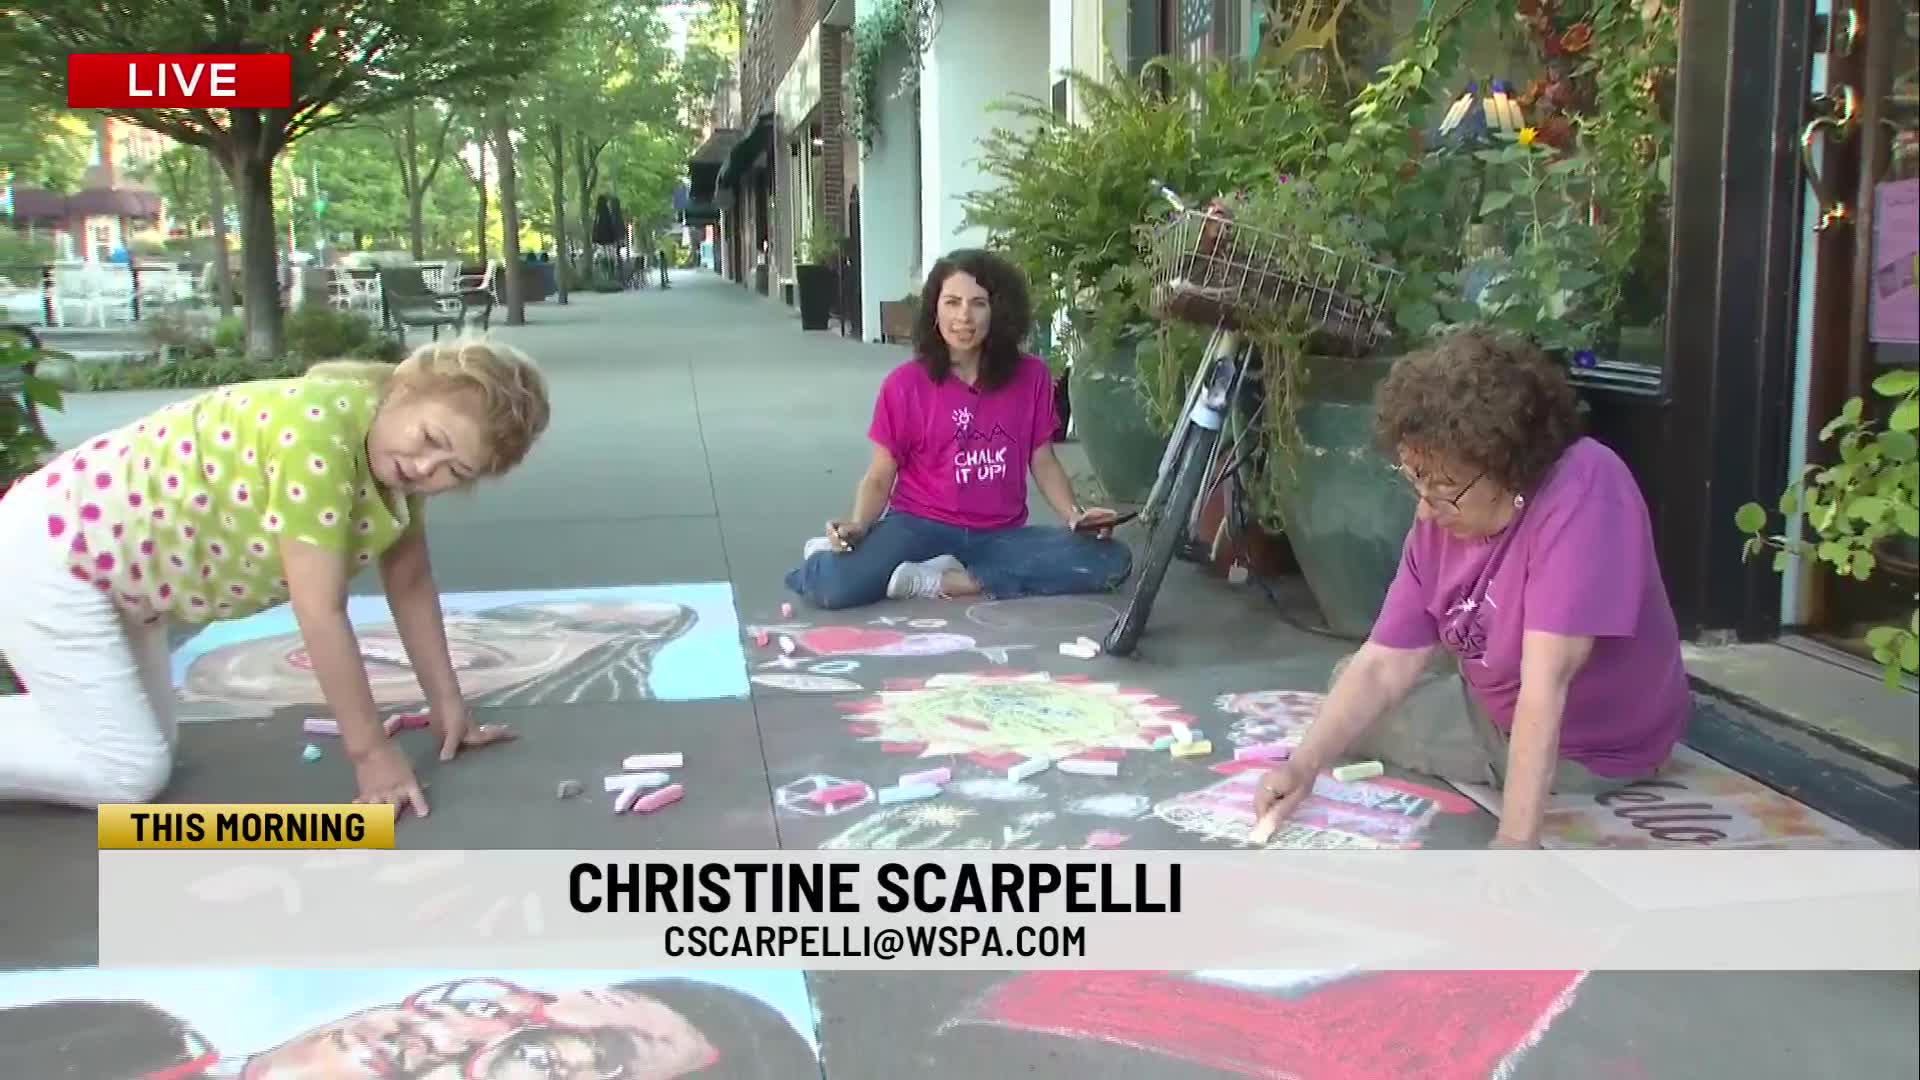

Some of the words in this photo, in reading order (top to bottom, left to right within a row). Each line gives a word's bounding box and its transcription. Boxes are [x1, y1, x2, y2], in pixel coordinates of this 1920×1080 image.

[954, 446, 1007, 466] CHALK
[955, 467, 972, 484] IT
[977, 463, 1007, 481] UP!
[1593, 779, 1734, 846] ello
